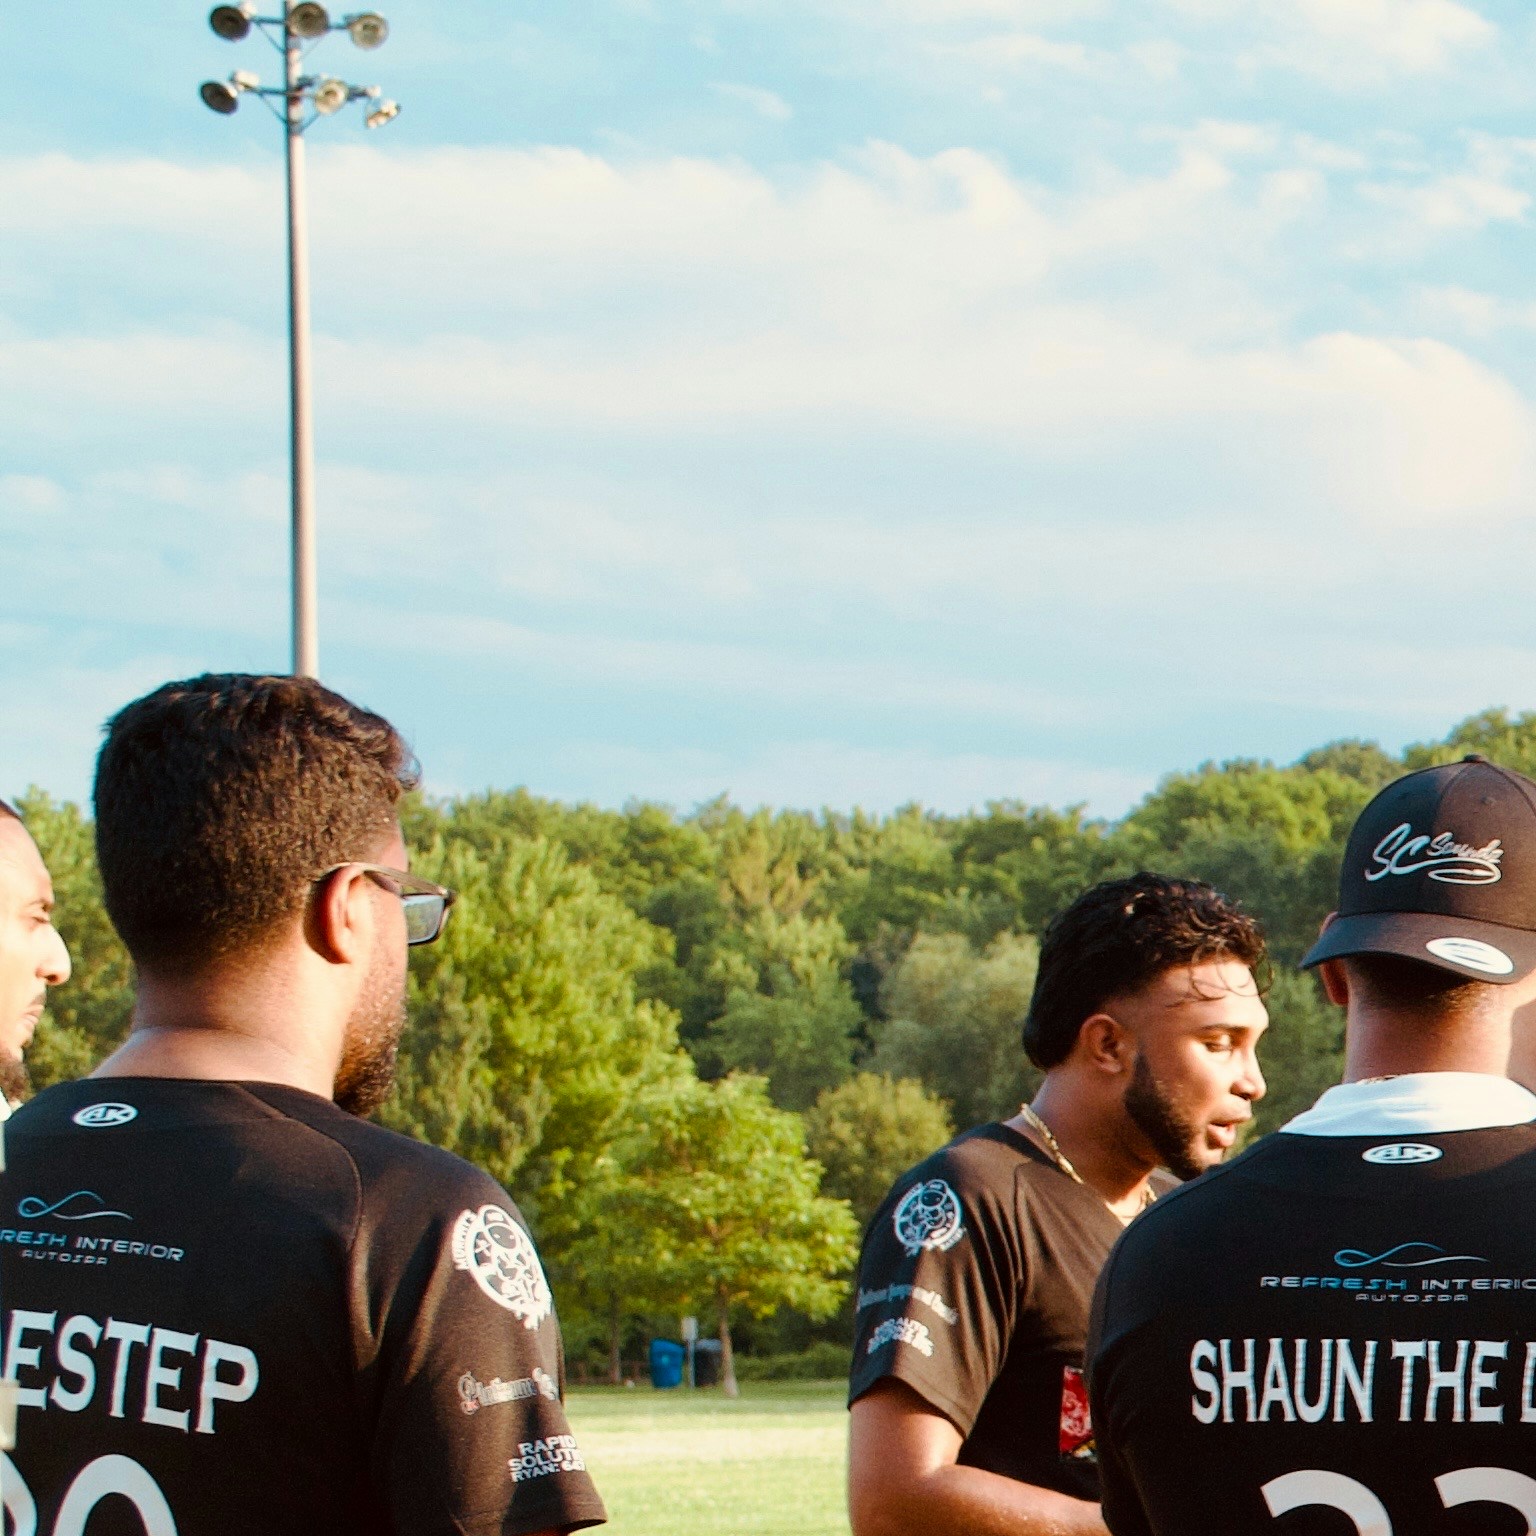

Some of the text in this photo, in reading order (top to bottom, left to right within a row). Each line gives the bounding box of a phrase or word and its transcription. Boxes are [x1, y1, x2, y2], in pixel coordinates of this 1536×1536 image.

[21, 1248, 109, 1266] AUTOSPA
[75, 1236, 186, 1262] INTERIOR
[1260, 1276, 1407, 1291] REFRESH
[1354, 1293, 1469, 1303] AUTOSPA
[3, 1309, 259, 1434] ESTEP
[1189, 1338, 1378, 1424] SHAUN
[1390, 1339, 1509, 1425] THE
[517, 1435, 578, 1457] RAPID
